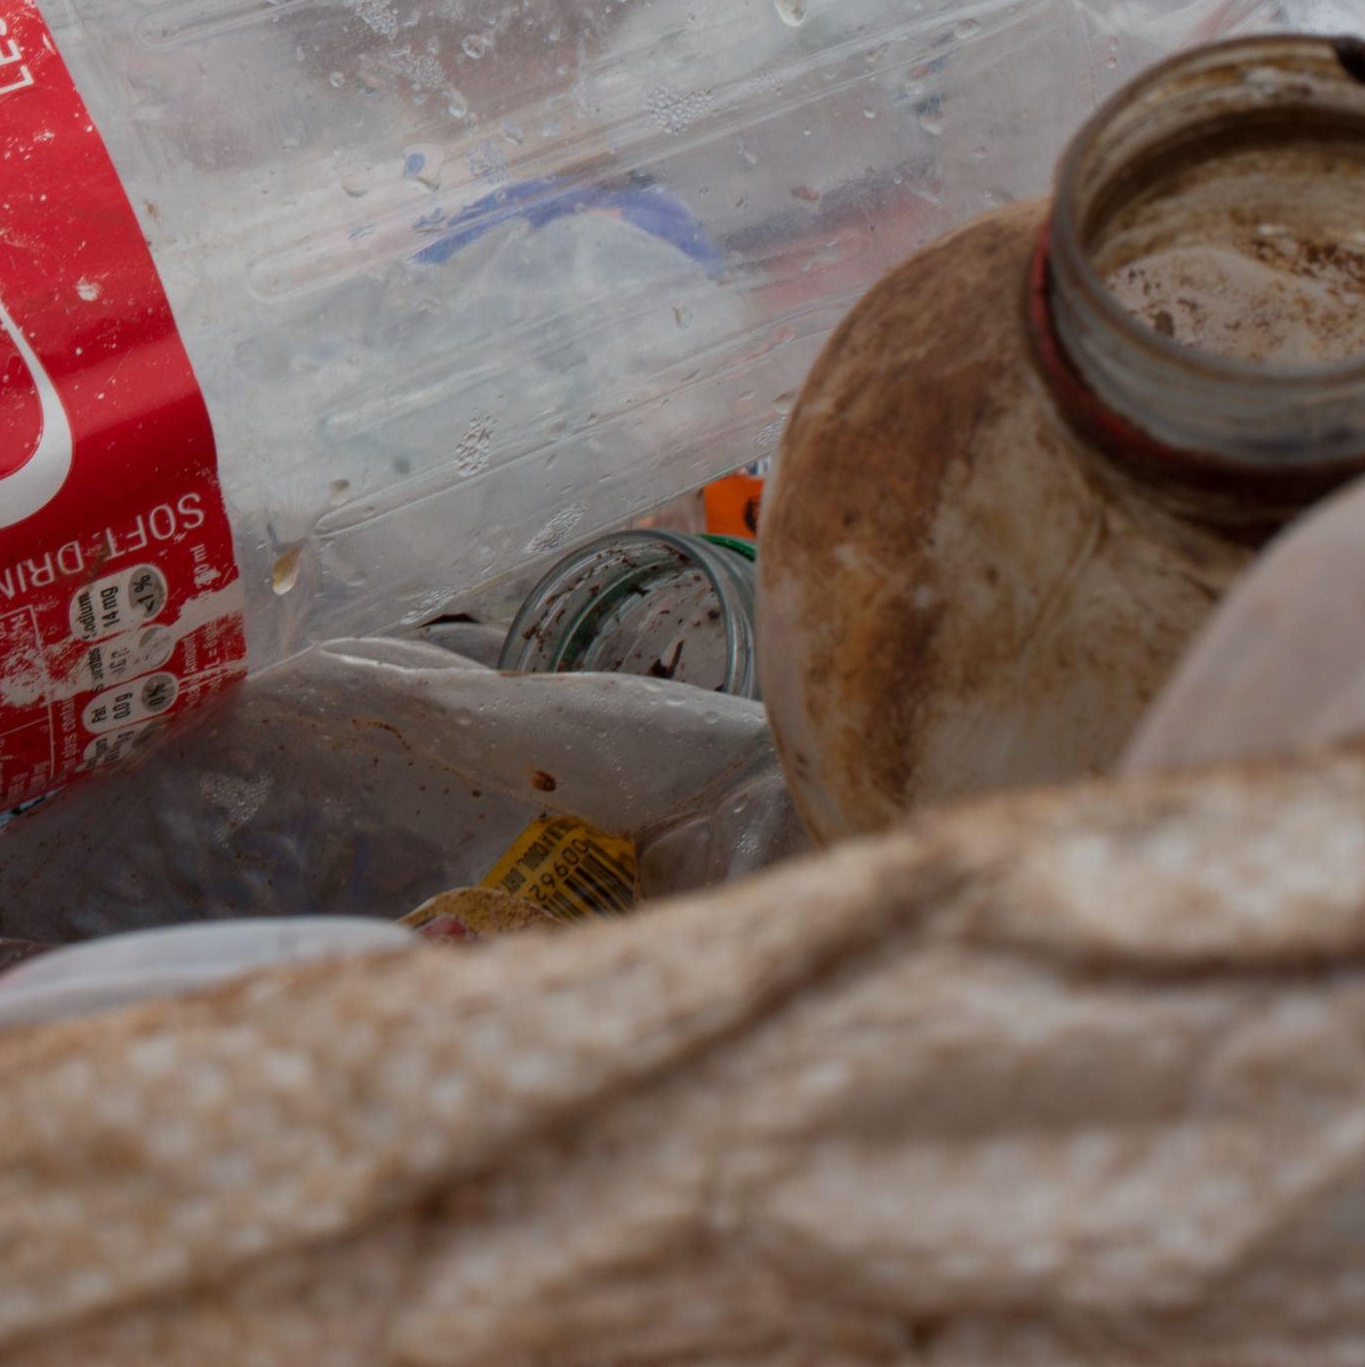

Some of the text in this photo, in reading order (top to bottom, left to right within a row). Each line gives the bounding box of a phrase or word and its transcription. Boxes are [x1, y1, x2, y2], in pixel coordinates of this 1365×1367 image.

[105, 492, 204, 560] SOFT
[101, 586, 119, 609] mg
[102, 610, 120, 627] 14
[57, 696, 76, 732] contai
[88, 705, 108, 723] Fat
[111, 702, 132, 719] 0.0
